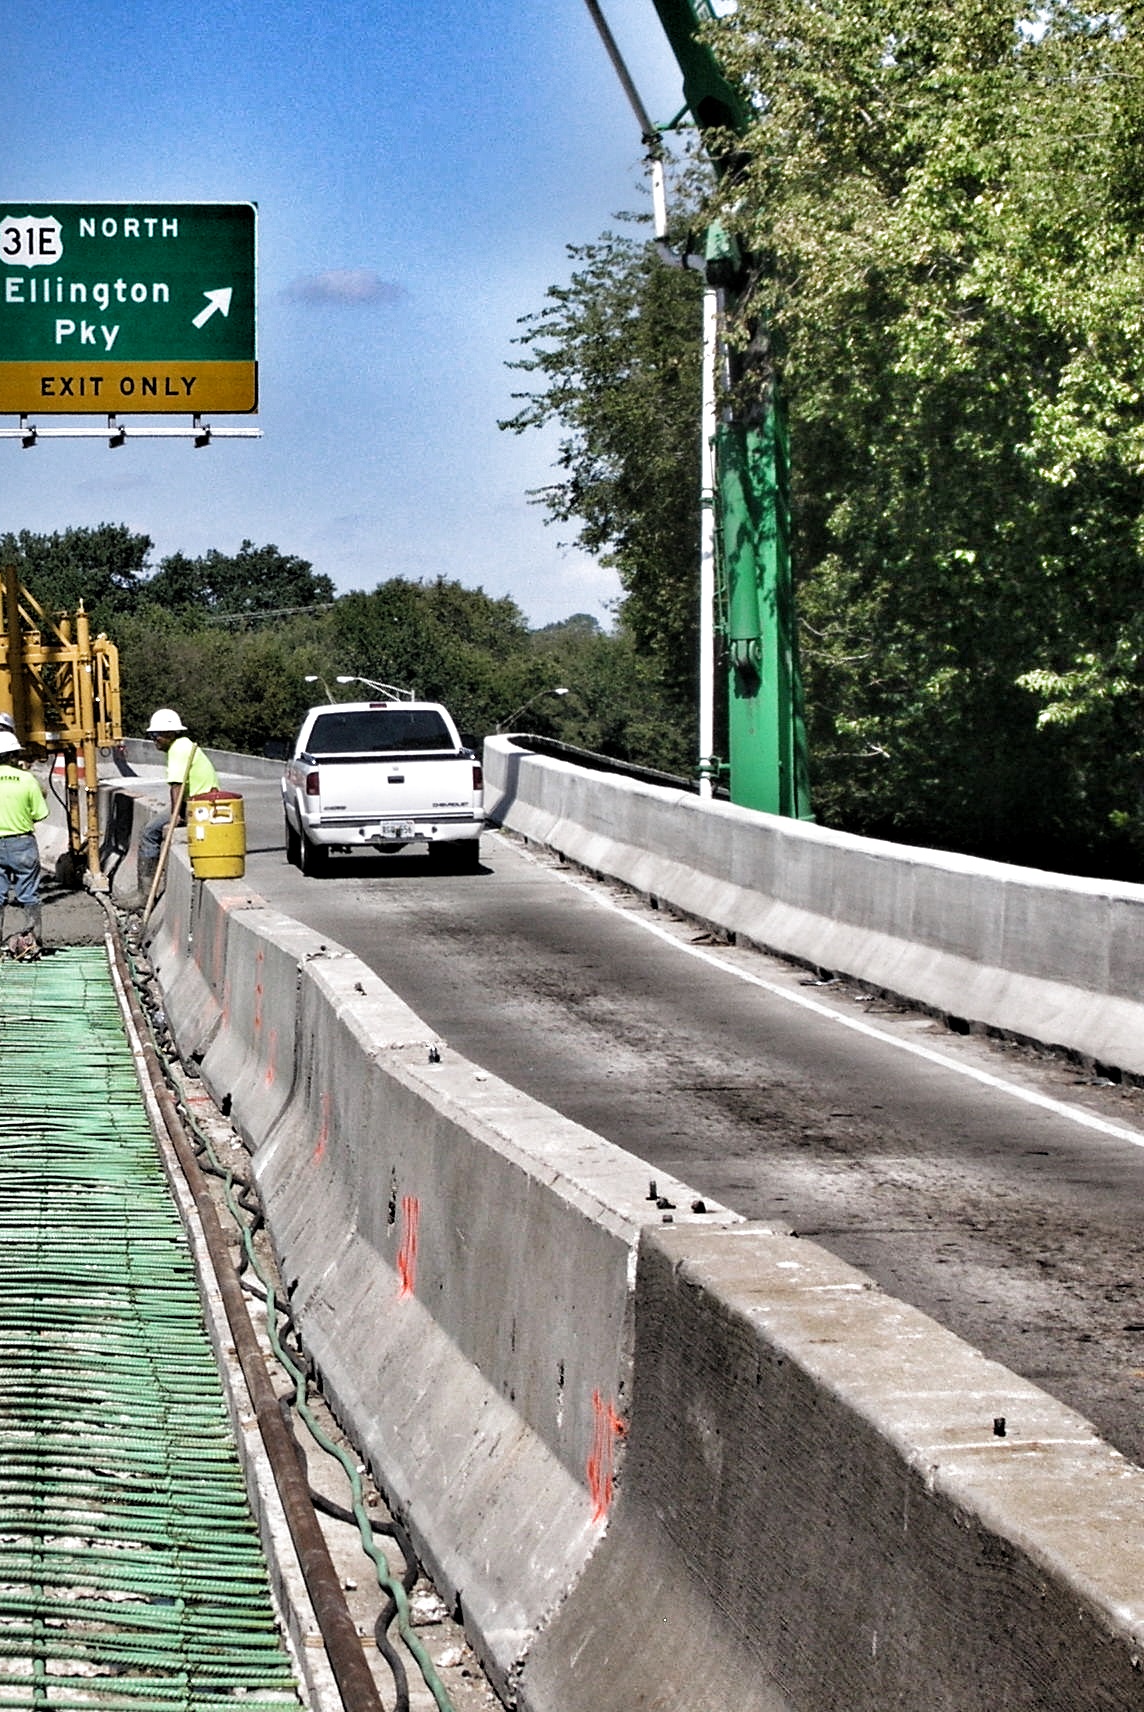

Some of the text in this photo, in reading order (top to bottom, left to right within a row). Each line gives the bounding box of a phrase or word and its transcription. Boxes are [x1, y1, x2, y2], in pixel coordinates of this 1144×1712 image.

[2, 218, 179, 256] 31E NORTH
[5, 276, 170, 311] Ellington
[55, 319, 121, 351] Pky
[41, 376, 197, 396] EXIT ONLY
